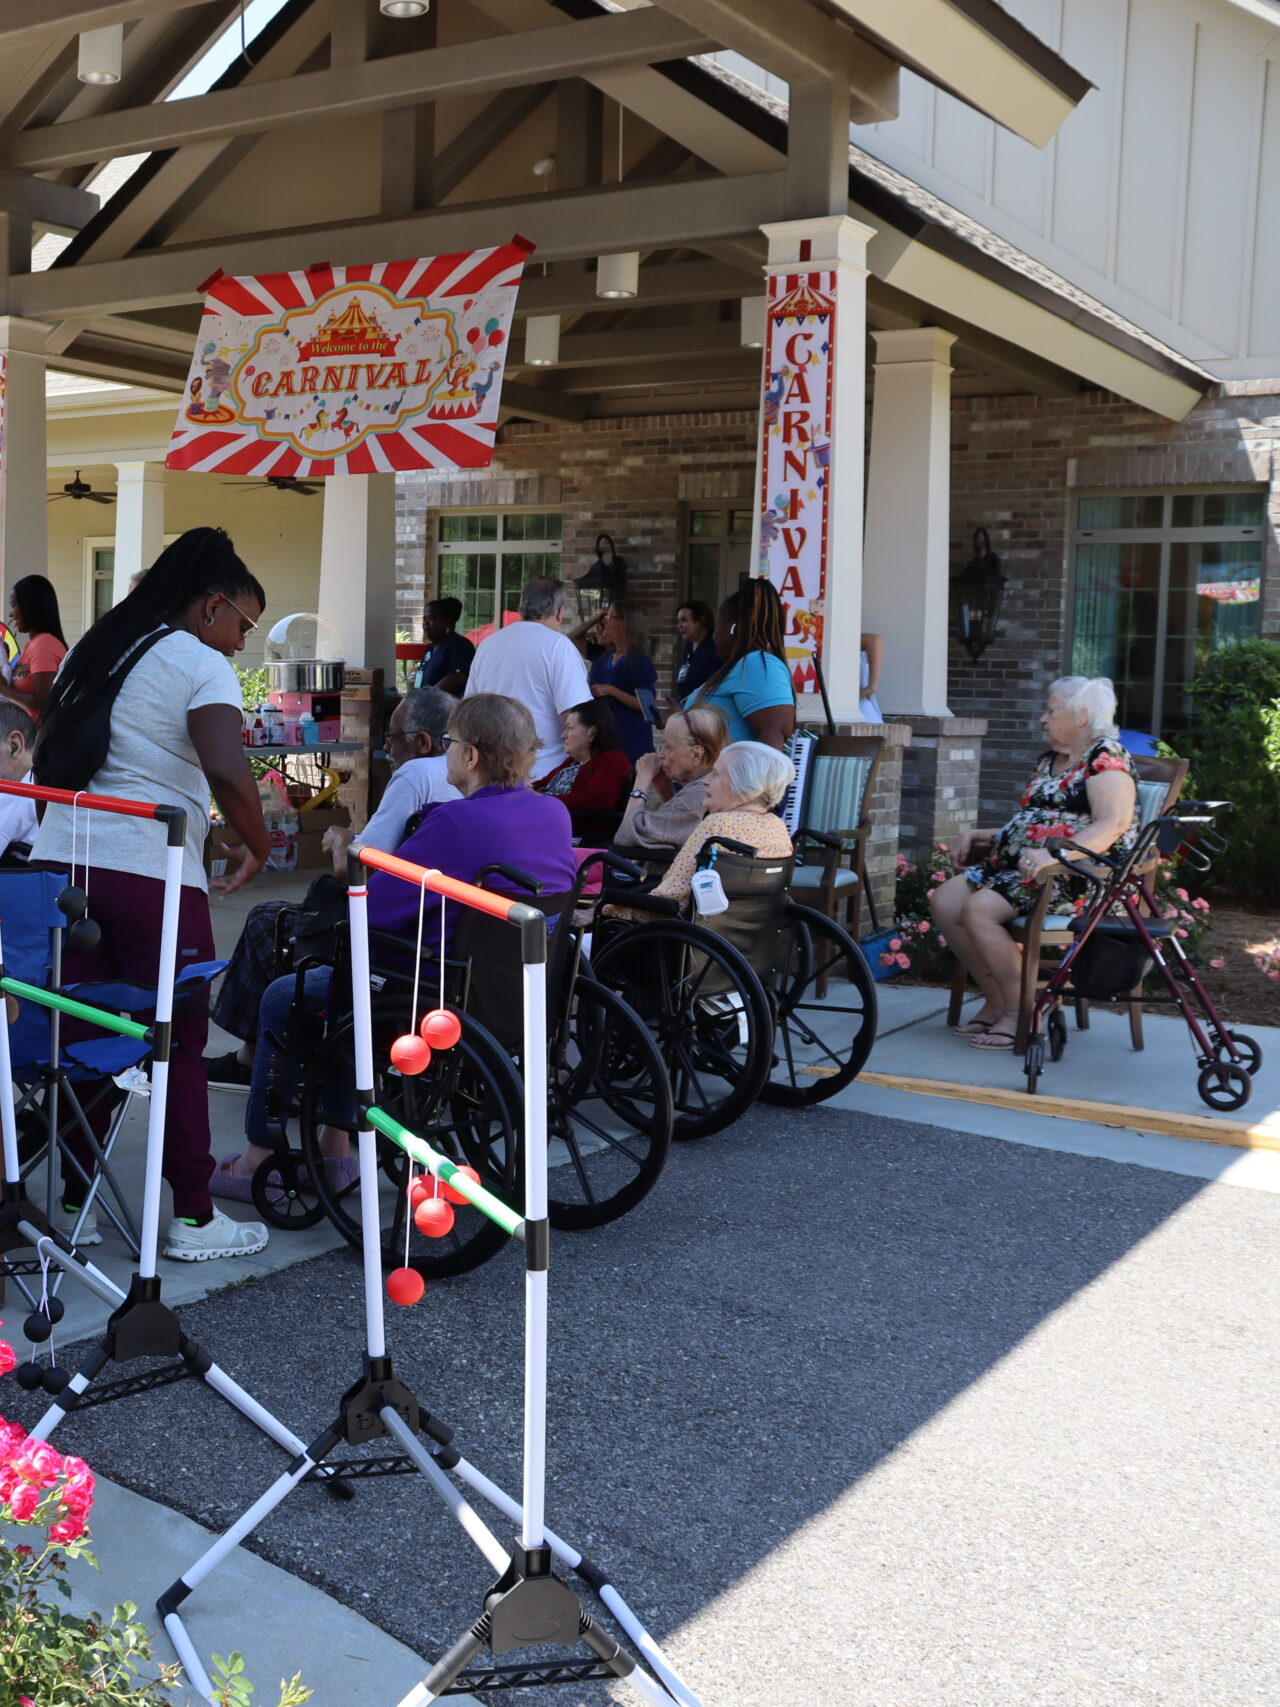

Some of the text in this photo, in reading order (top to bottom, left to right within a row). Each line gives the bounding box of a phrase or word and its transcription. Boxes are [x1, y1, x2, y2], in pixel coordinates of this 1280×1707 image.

[311, 341, 389, 353] Welcome to the
[251, 358, 433, 398] CARNIVAL
[778, 332, 814, 636] CARNIVAL
